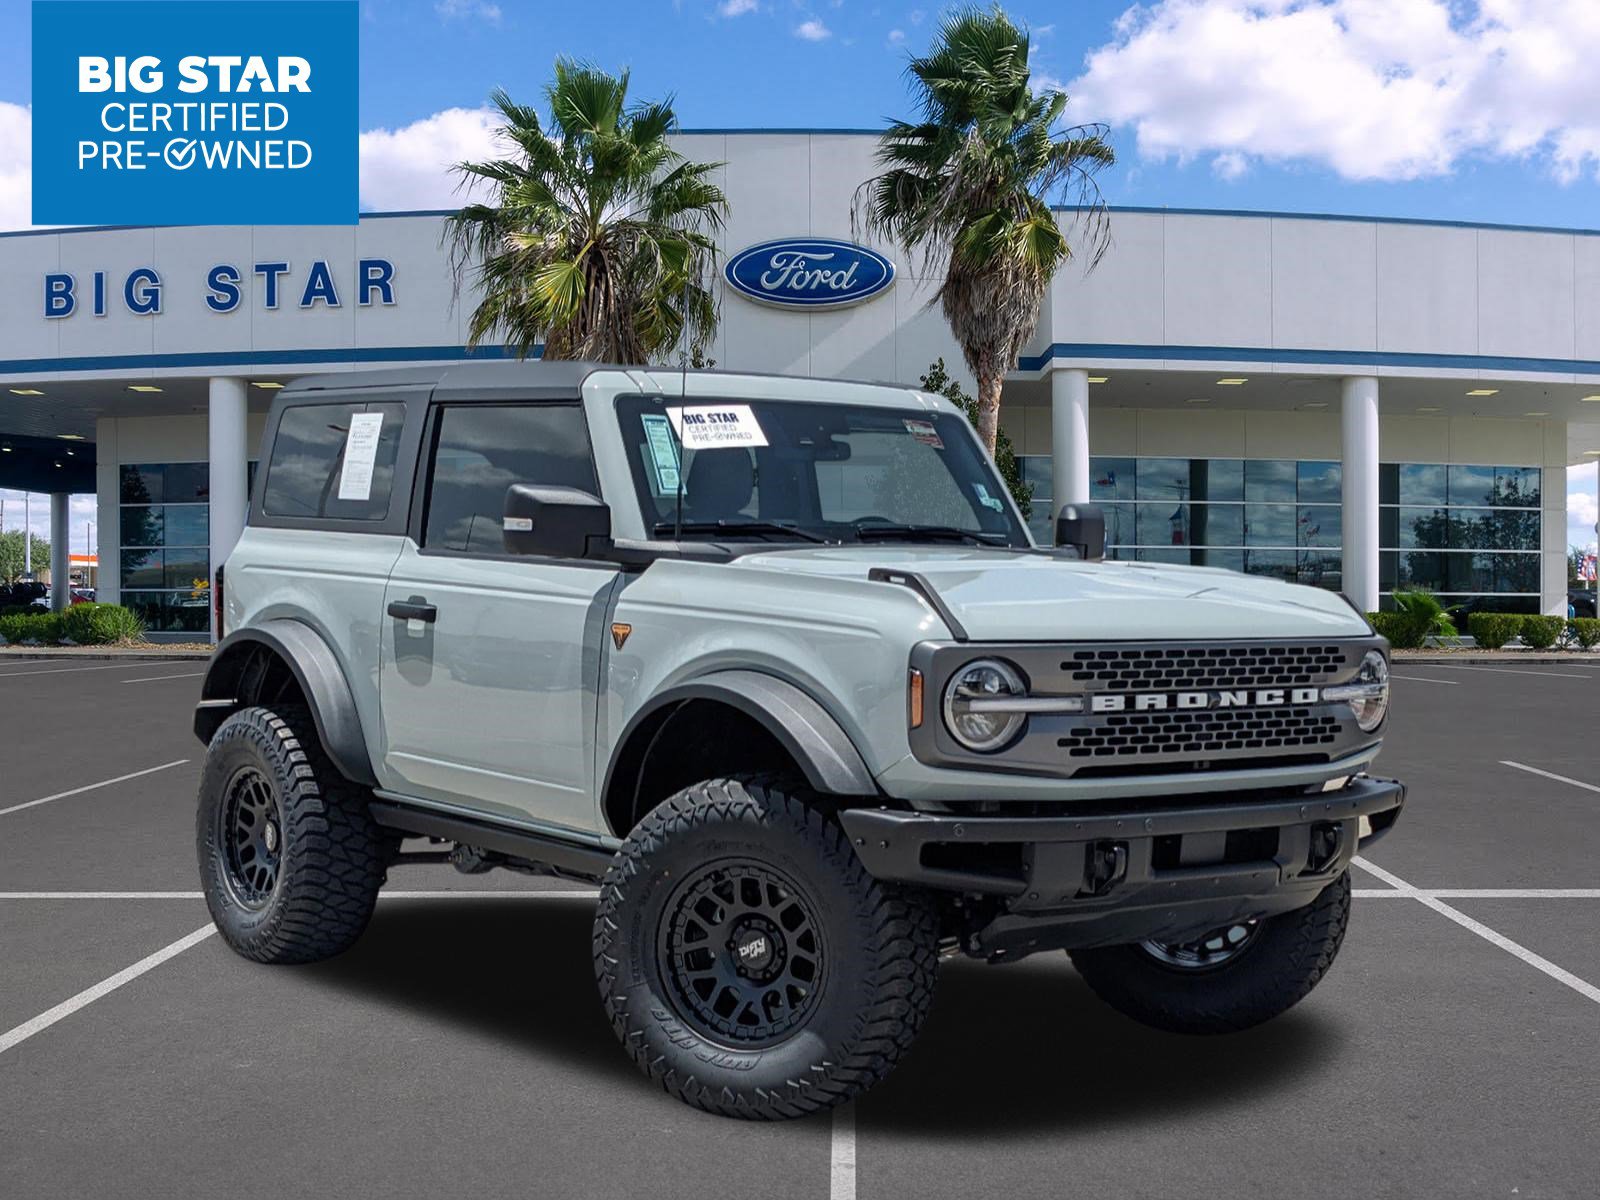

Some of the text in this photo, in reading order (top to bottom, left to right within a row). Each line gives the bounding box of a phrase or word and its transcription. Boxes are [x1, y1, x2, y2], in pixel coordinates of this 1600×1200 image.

[760, 251, 859, 290] Ford
[44, 258, 397, 319] BIG STAR
[682, 412, 740, 425] BIG STAR
[1091, 687, 1319, 712] BRONCO
